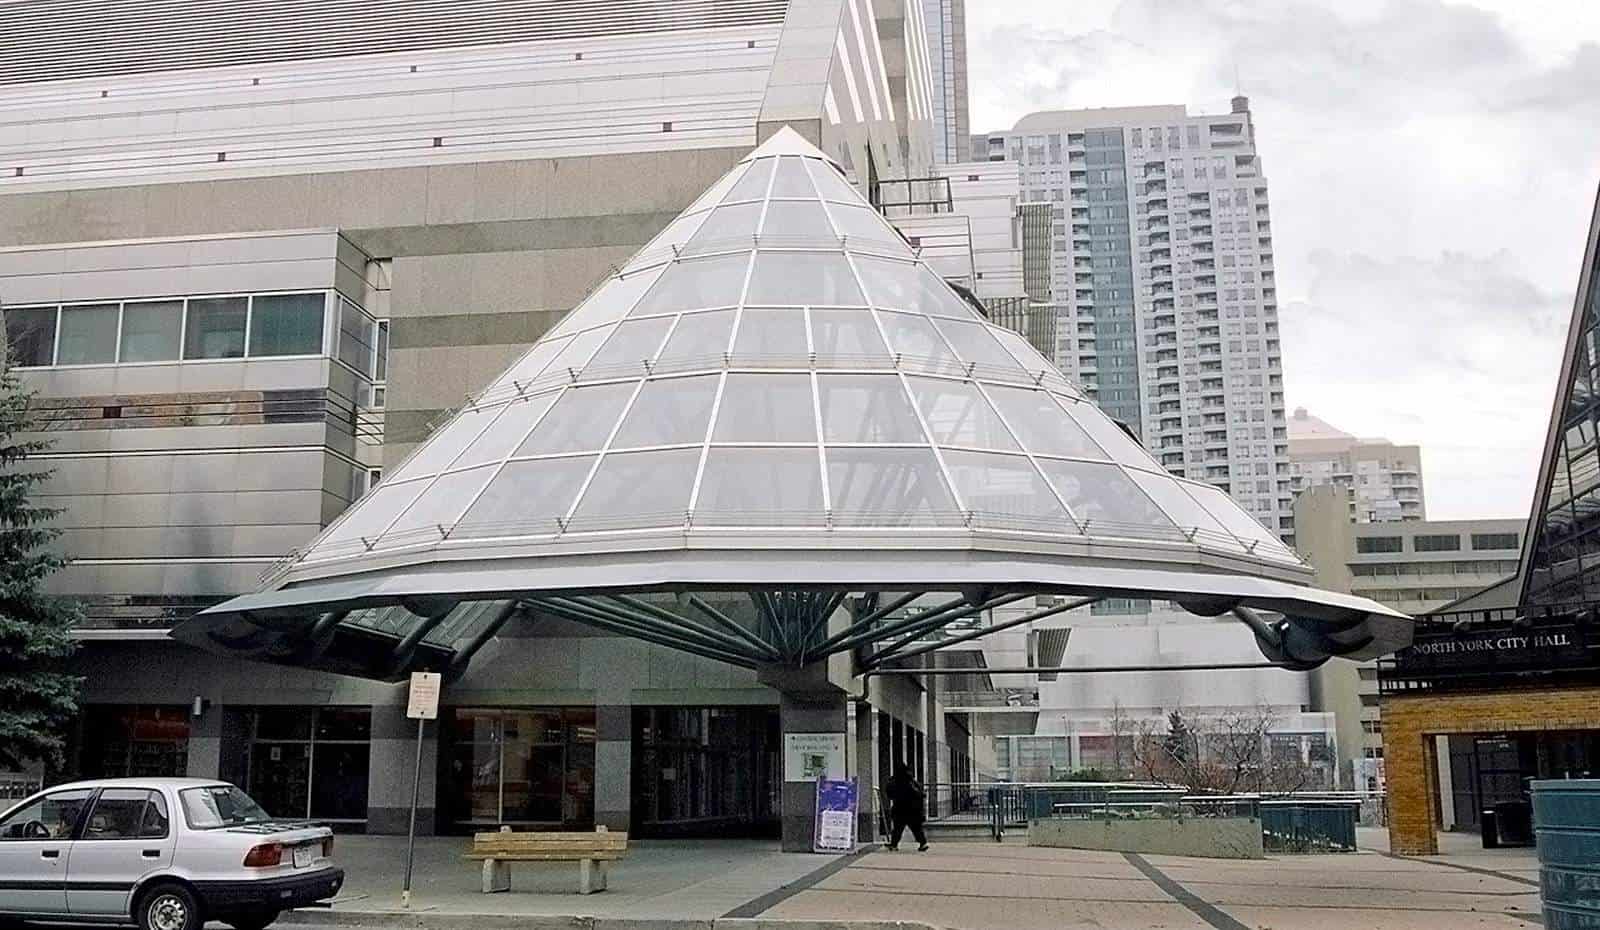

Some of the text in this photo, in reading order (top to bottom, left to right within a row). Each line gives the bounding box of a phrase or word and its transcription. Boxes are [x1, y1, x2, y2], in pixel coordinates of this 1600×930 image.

[1413, 634, 1570, 655] NORTH YORK CITY HALL
